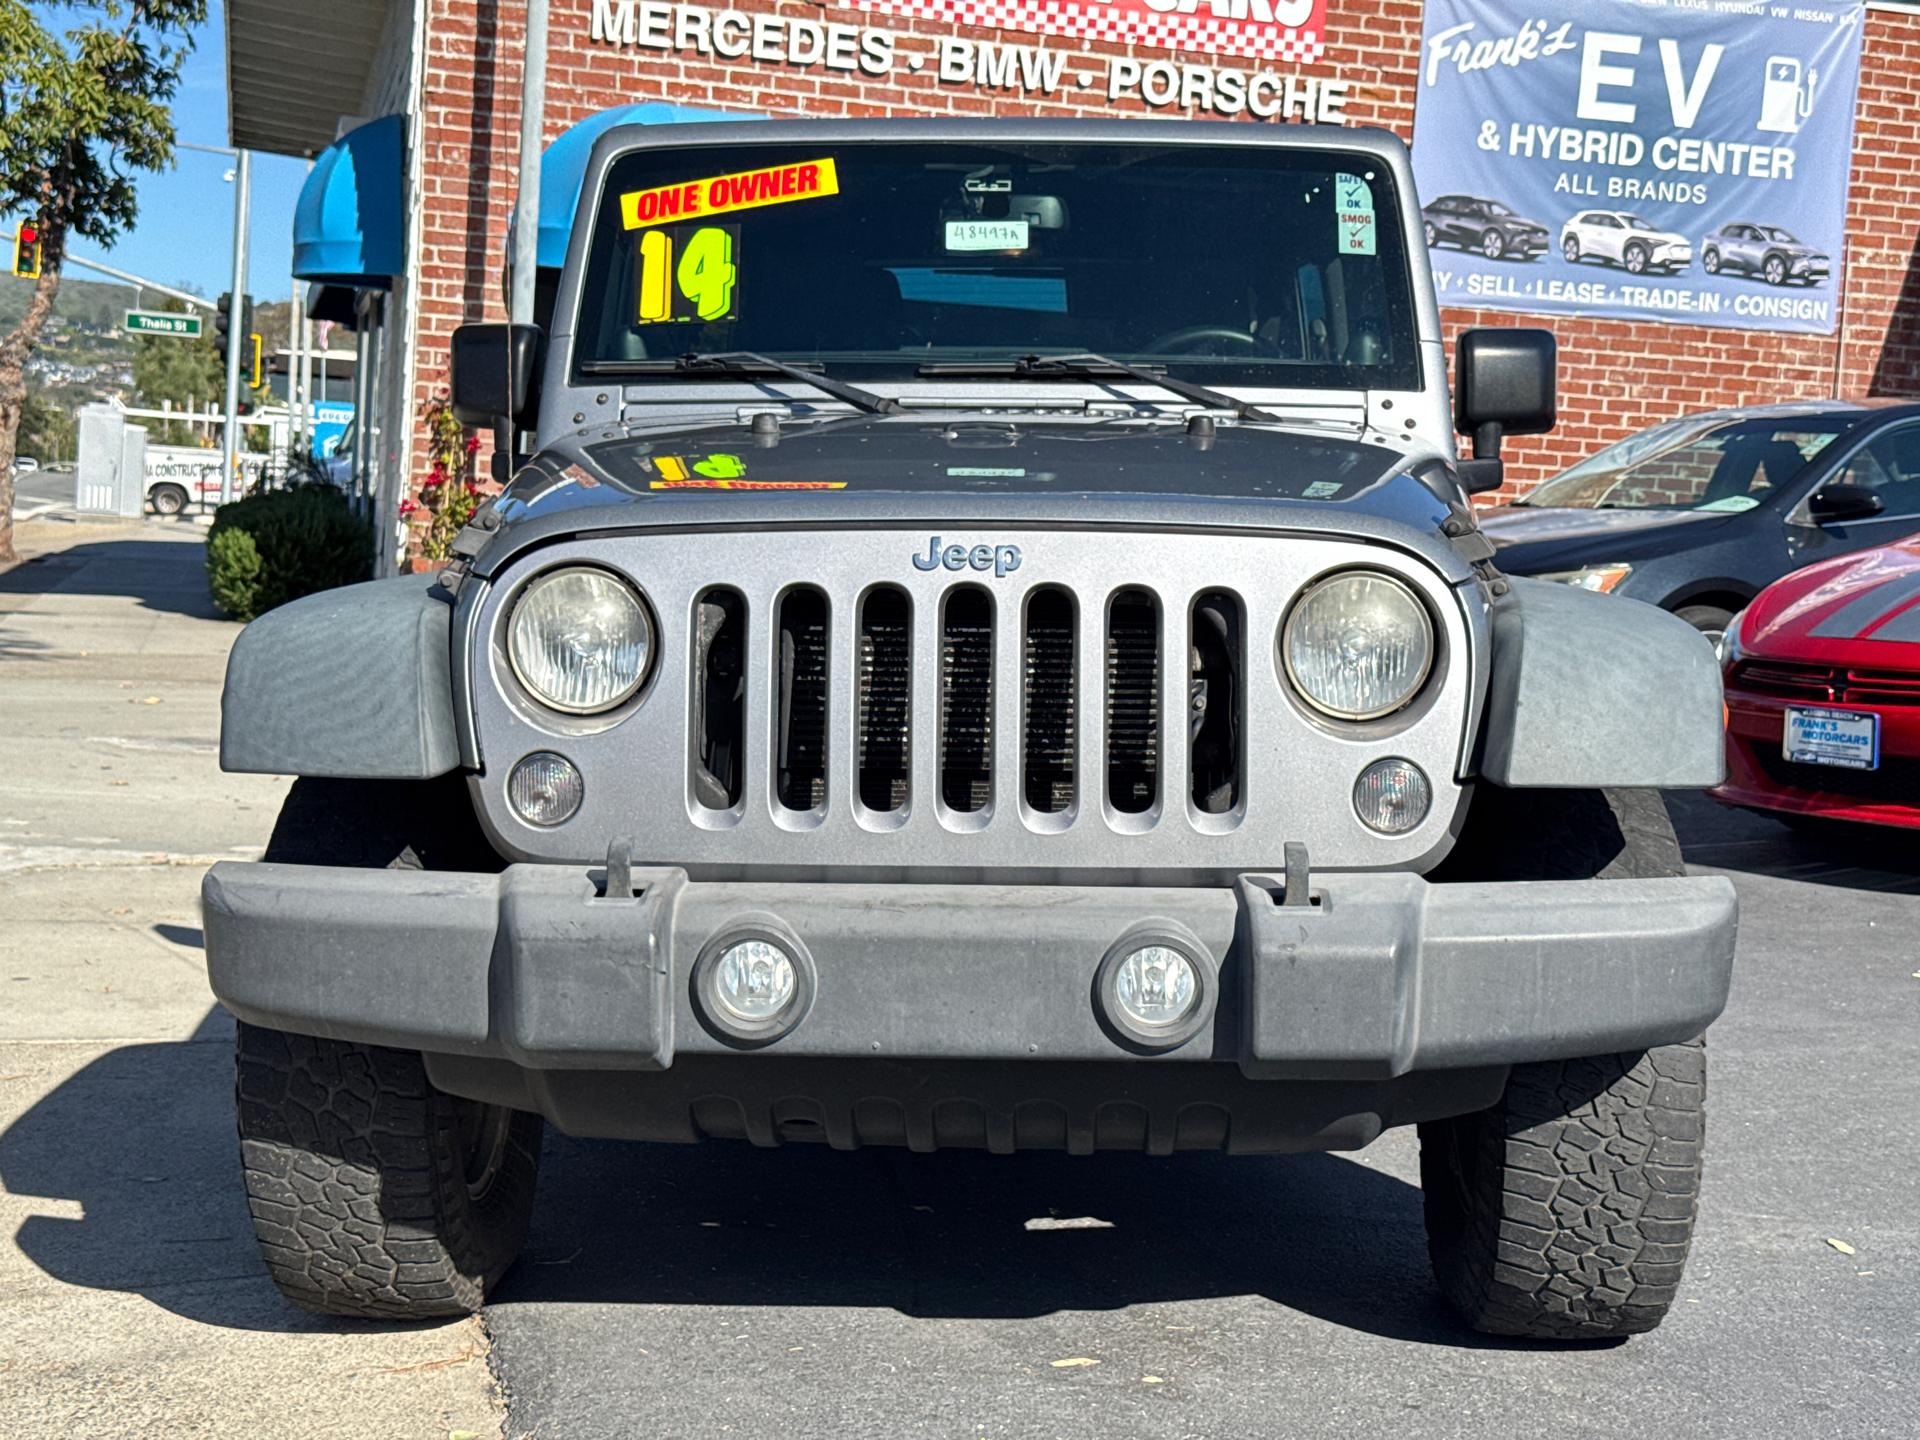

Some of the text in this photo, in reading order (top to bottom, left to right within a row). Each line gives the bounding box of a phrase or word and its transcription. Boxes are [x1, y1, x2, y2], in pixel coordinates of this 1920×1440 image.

[1715, 3, 1765, 16] HYUNDAI
[1770, 7, 1788, 18] VW
[1794, 9, 1834, 23] NISSAN
[591, 0, 1350, 124] MERCEDES BMW PORSCHE
[1426, 19, 1578, 87] Frank's
[1477, 120, 1796, 180] & HYBRID CENTER
[637, 164, 821, 222] ONE OWNER
[1554, 173, 1708, 204] ALL BRANDS
[1347, 200, 1361, 208] OK
[1341, 214, 1371, 224] SMOG
[954, 225, 1019, 241] 48497A
[1350, 240, 1364, 248] OK
[640, 228, 736, 322] 14
[1467, 273, 1521, 297] SELL
[1536, 279, 1606, 304] LEASE
[1620, 286, 1720, 312] TRADE-IN
[1734, 294, 1828, 320] CONSIGN
[139, 317, 187, 332] Thalia St
[912, 536, 1023, 578] Jeep
[1792, 717, 1838, 731] FRANK'S
[1802, 730, 1869, 745] MOTORCARS
